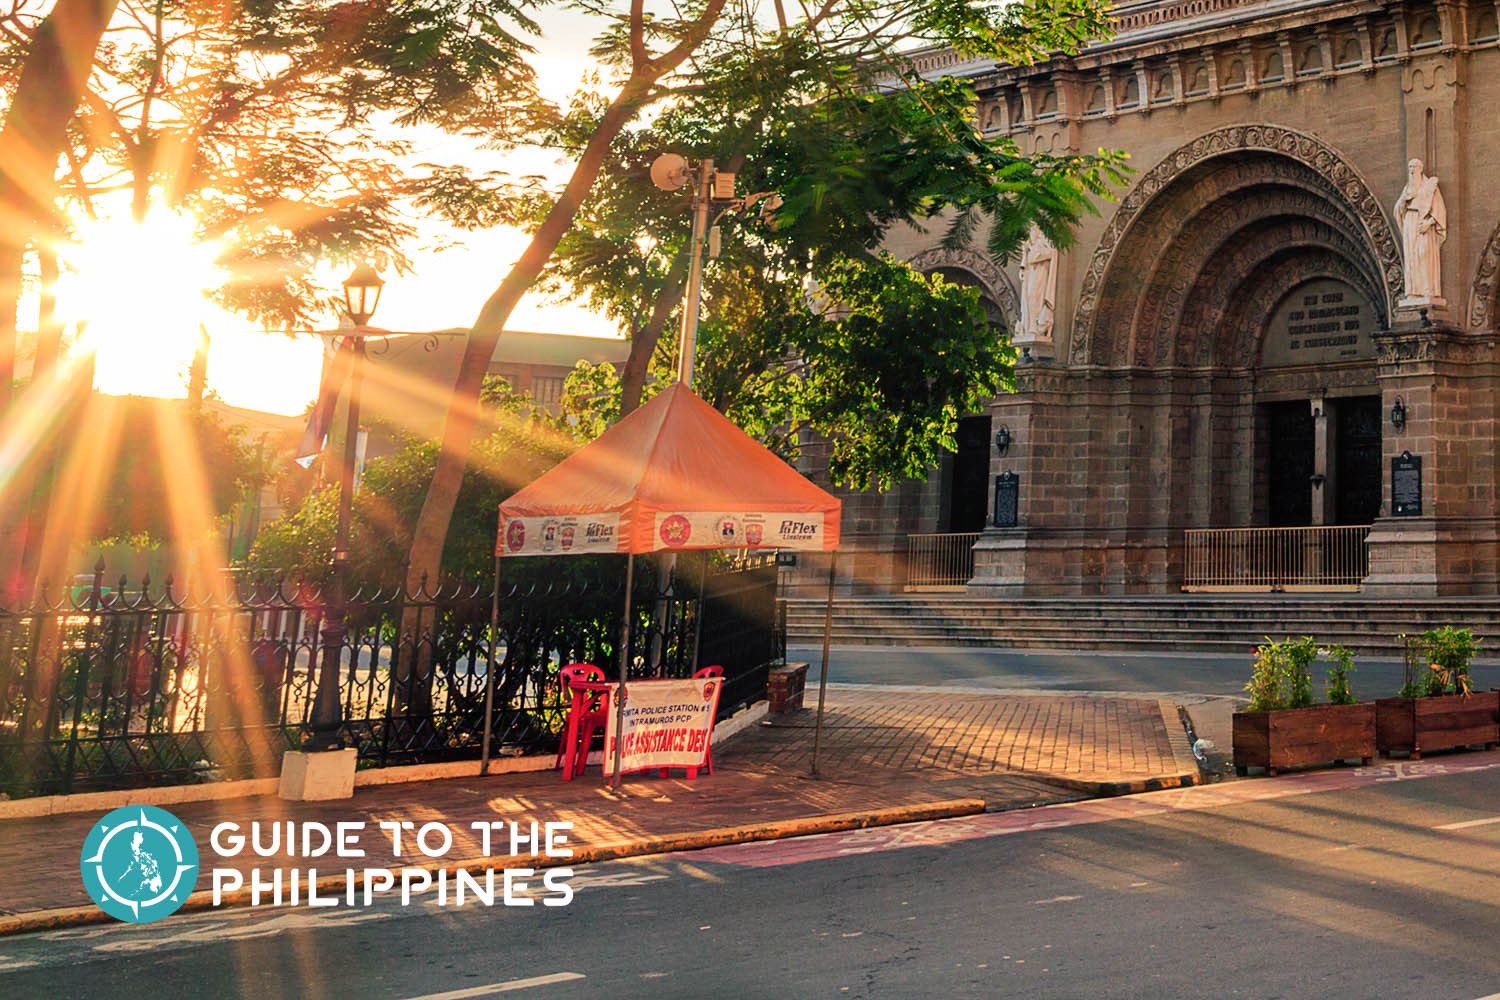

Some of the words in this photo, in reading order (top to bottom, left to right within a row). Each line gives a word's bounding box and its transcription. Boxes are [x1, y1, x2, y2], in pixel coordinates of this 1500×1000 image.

[641, 706, 666, 716] POLICE
[668, 704, 698, 713] STATION
[630, 715, 674, 726] INTRAMUROS
[675, 714, 692, 723] PCP
[609, 733, 635, 760] PLICE
[634, 728, 686, 754] ASSISTANCE
